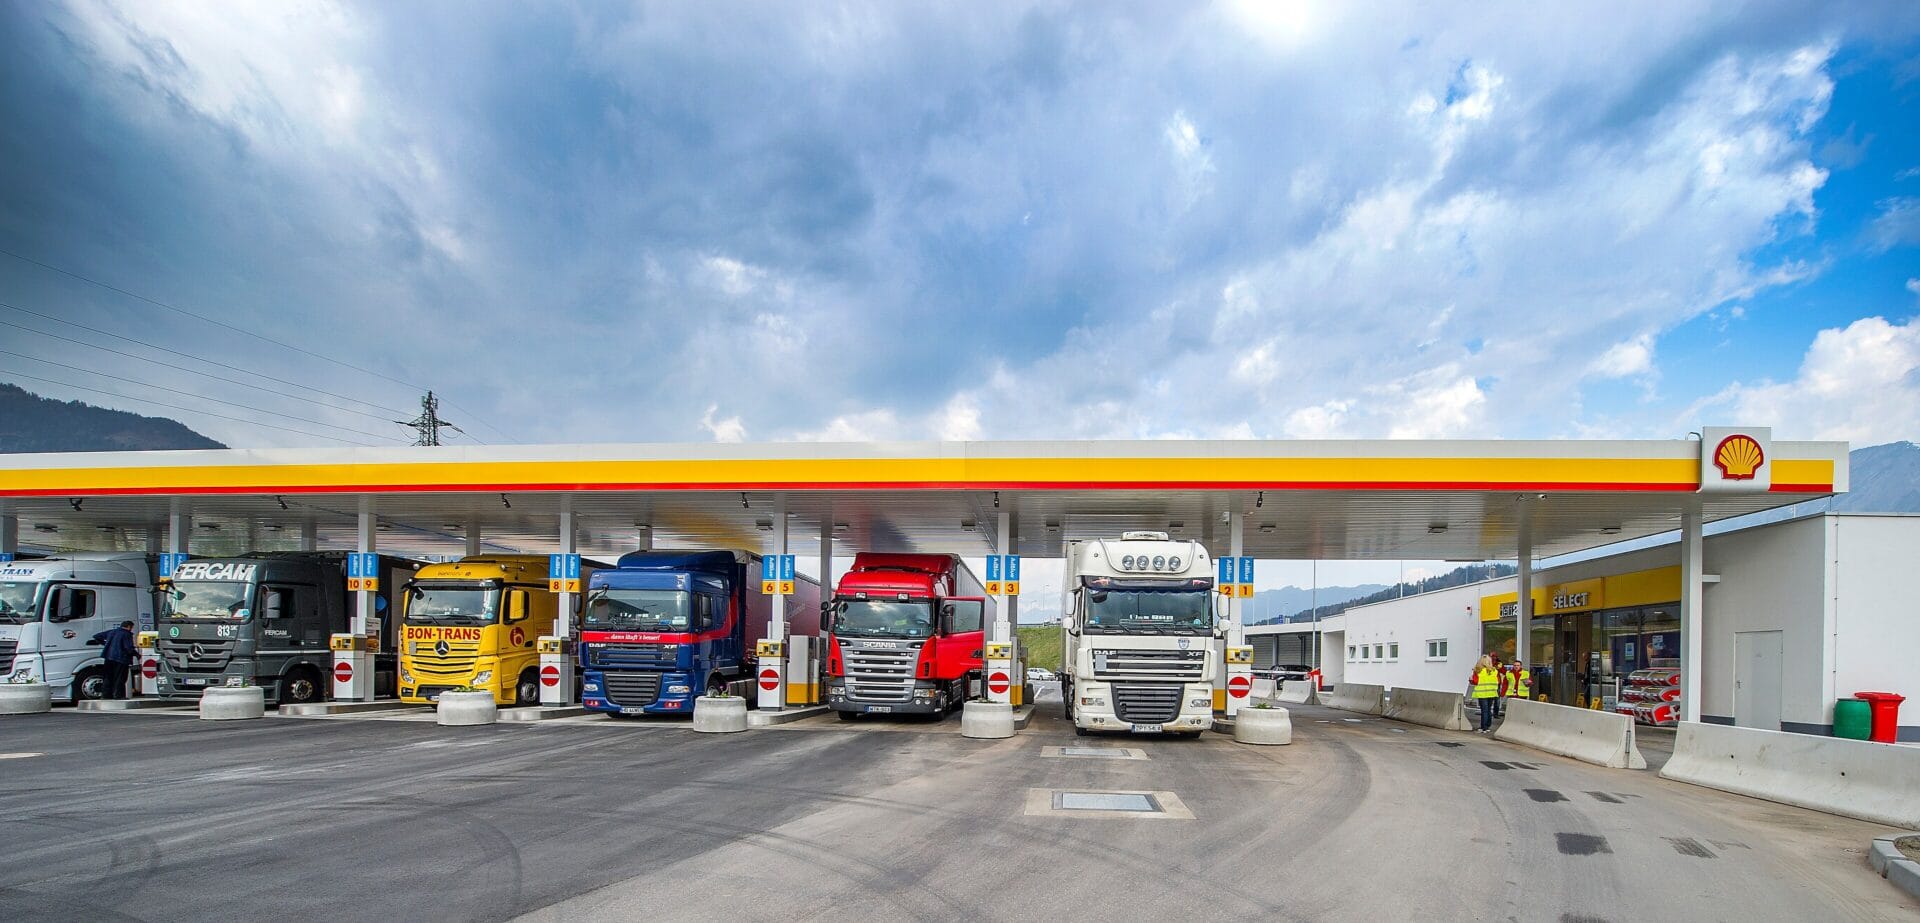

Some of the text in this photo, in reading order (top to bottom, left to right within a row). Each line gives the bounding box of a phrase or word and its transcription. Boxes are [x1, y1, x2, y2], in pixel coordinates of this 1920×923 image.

[172, 563, 257, 580] FERCAM
[349, 580, 359, 589] 10
[365, 580, 372, 589] 9
[553, 581, 559, 590] 8
[568, 582, 575, 590] 7
[766, 583, 773, 592] 6
[782, 583, 789, 592] 5
[990, 583, 998, 593] 4
[1007, 583, 1015, 593] 3
[1224, 586, 1231, 595] 2
[1243, 586, 1248, 595] 1
[1552, 592, 1588, 609] SELECT
[217, 625, 230, 637] 813
[263, 629, 288, 637] FERCAM
[407, 628, 481, 640] BON-TRANS
